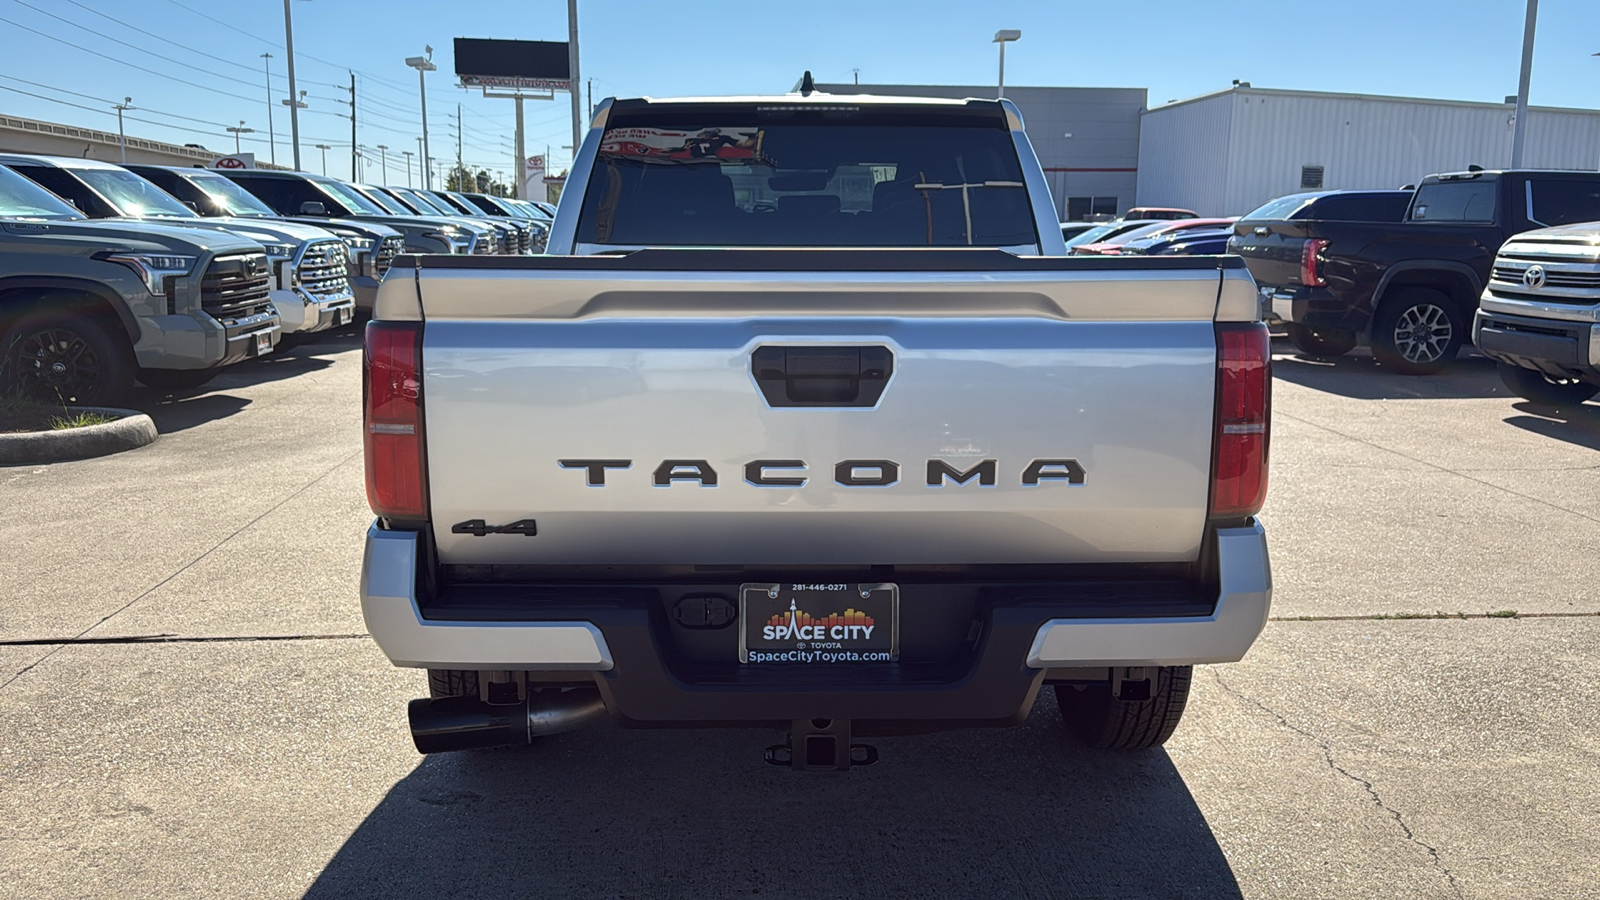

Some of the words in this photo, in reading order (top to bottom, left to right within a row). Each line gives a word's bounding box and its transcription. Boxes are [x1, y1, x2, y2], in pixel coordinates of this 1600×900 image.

[557, 458, 1088, 488] TACOMA
[792, 583, 847, 591] 281-446-0271
[763, 624, 825, 640] SPACE
[830, 625, 875, 640] CITY
[811, 642, 842, 650] TOYOTA
[749, 651, 890, 663] SpaceCityToyota.com
